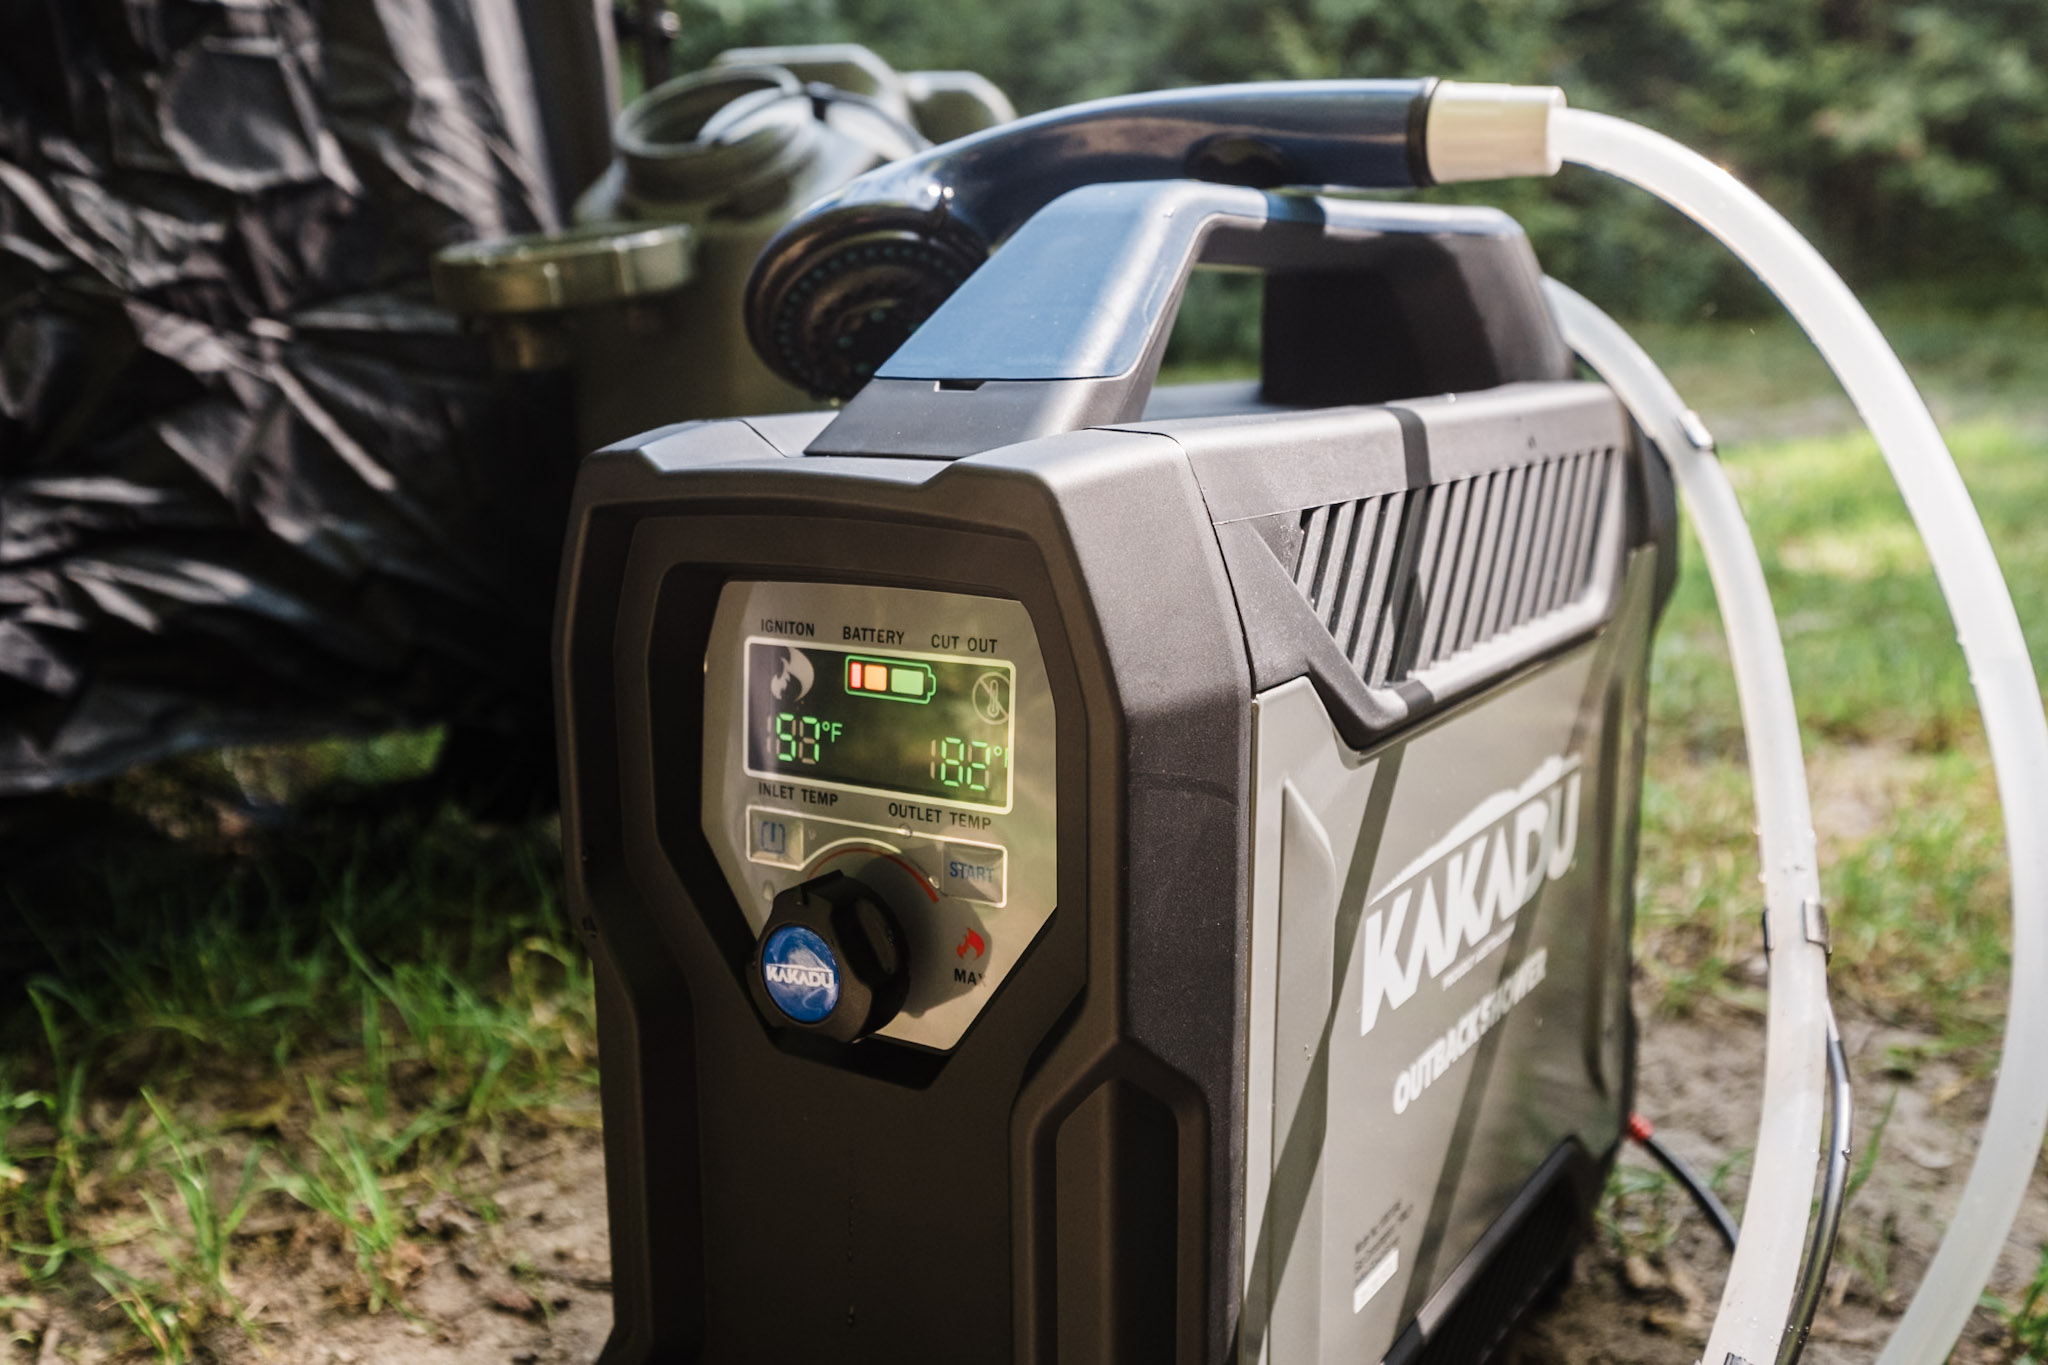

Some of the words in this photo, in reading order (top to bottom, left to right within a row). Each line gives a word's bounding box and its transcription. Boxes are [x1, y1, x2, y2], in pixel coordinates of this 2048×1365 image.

[760, 618, 815, 637] IGNITON
[842, 626, 905, 645] BATTERY
[931, 634, 959, 650] CUT
[967, 638, 998, 654] OUT
[758, 782, 794, 800] INLET
[801, 788, 839, 807] TEMP
[888, 802, 942, 823] OUTLET
[949, 812, 992, 831] TEMP
[949, 861, 995, 884] START
[1360, 771, 1582, 1037] KAKADU
[766, 964, 835, 989] KAKADU
